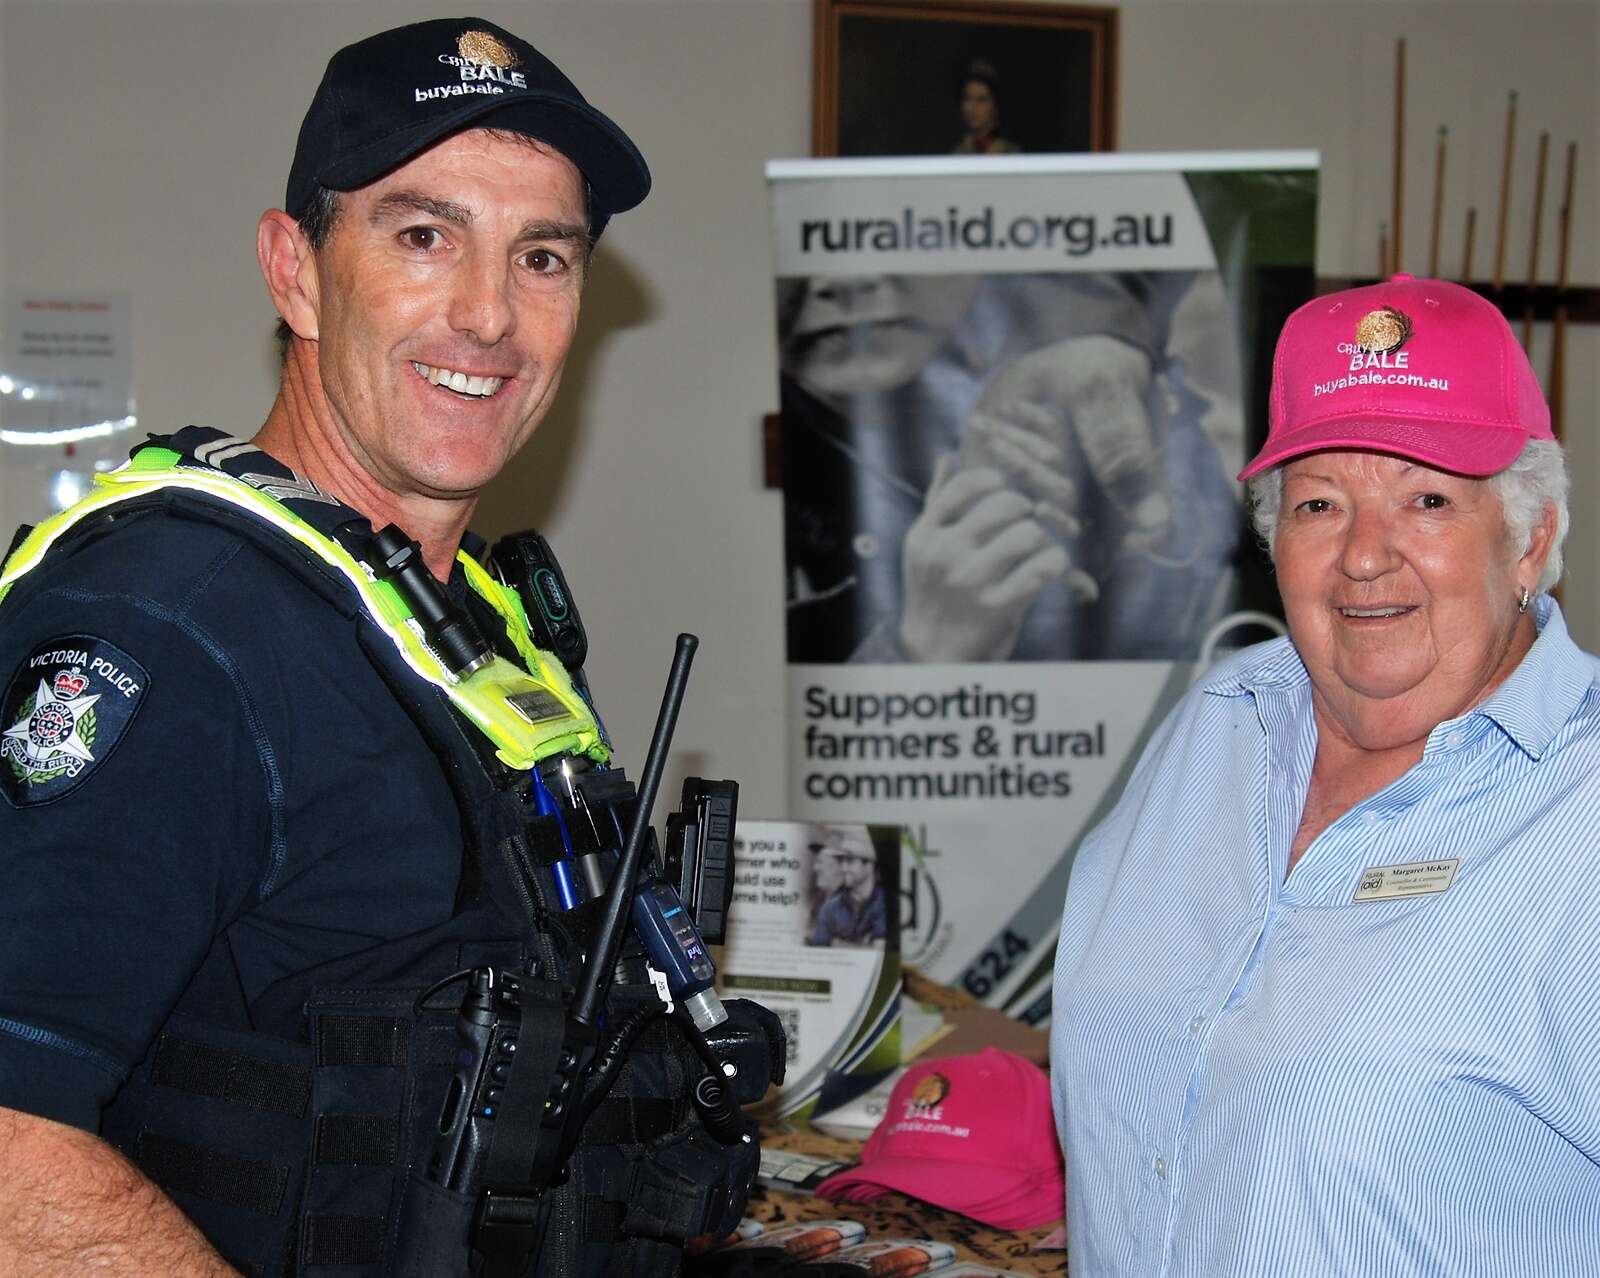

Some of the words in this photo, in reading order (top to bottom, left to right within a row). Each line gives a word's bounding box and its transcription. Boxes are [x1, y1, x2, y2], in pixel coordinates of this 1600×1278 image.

[460, 65, 528, 90] BALE
[801, 207, 1173, 256] ruralaid.org.au
[1349, 349, 1409, 371] BALE
[1314, 371, 1449, 397] buyabale.com.au
[30, 650, 88, 668] VICTORIA
[90, 657, 140, 698] POLICE
[33, 702, 73, 728] VICTORIA
[805, 686, 1035, 724] Supporting
[29, 731, 62, 746] POLICE
[805, 725, 960, 759] farmers
[971, 725, 999, 757] &
[1013, 723, 1105, 757] rural
[28, 759, 46, 770] THE
[47, 756, 81, 769] RIGHT
[805, 764, 1071, 799] communities
[750, 841, 775, 853] you
[778, 842, 786, 851] a
[769, 857, 801, 870] who
[763, 877, 785, 887] use
[762, 890, 799, 905] help?
[963, 928, 1030, 999] 624
